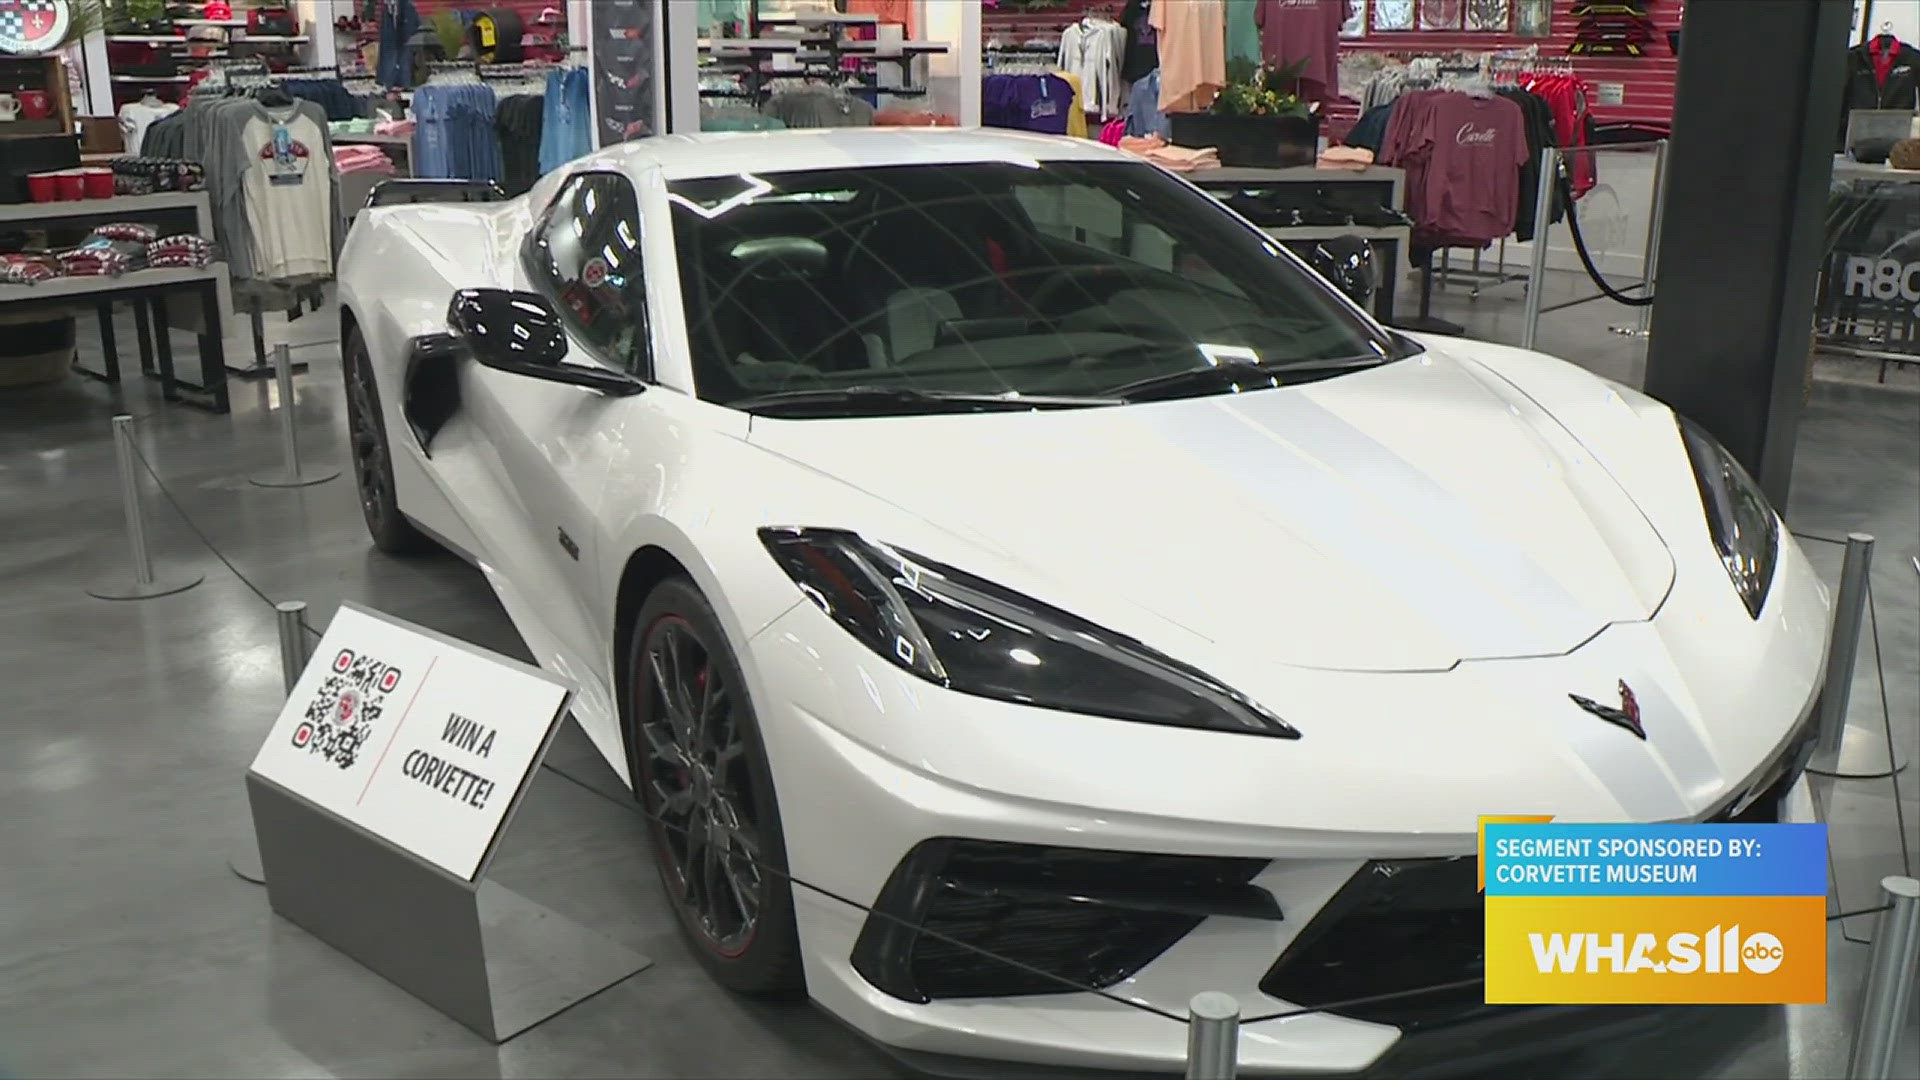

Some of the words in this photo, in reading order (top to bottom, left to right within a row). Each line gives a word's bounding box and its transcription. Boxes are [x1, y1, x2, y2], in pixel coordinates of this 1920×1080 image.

[441, 712, 484, 752] WIN
[476, 729, 497, 758] A
[402, 749, 495, 810] CORVETTE!
